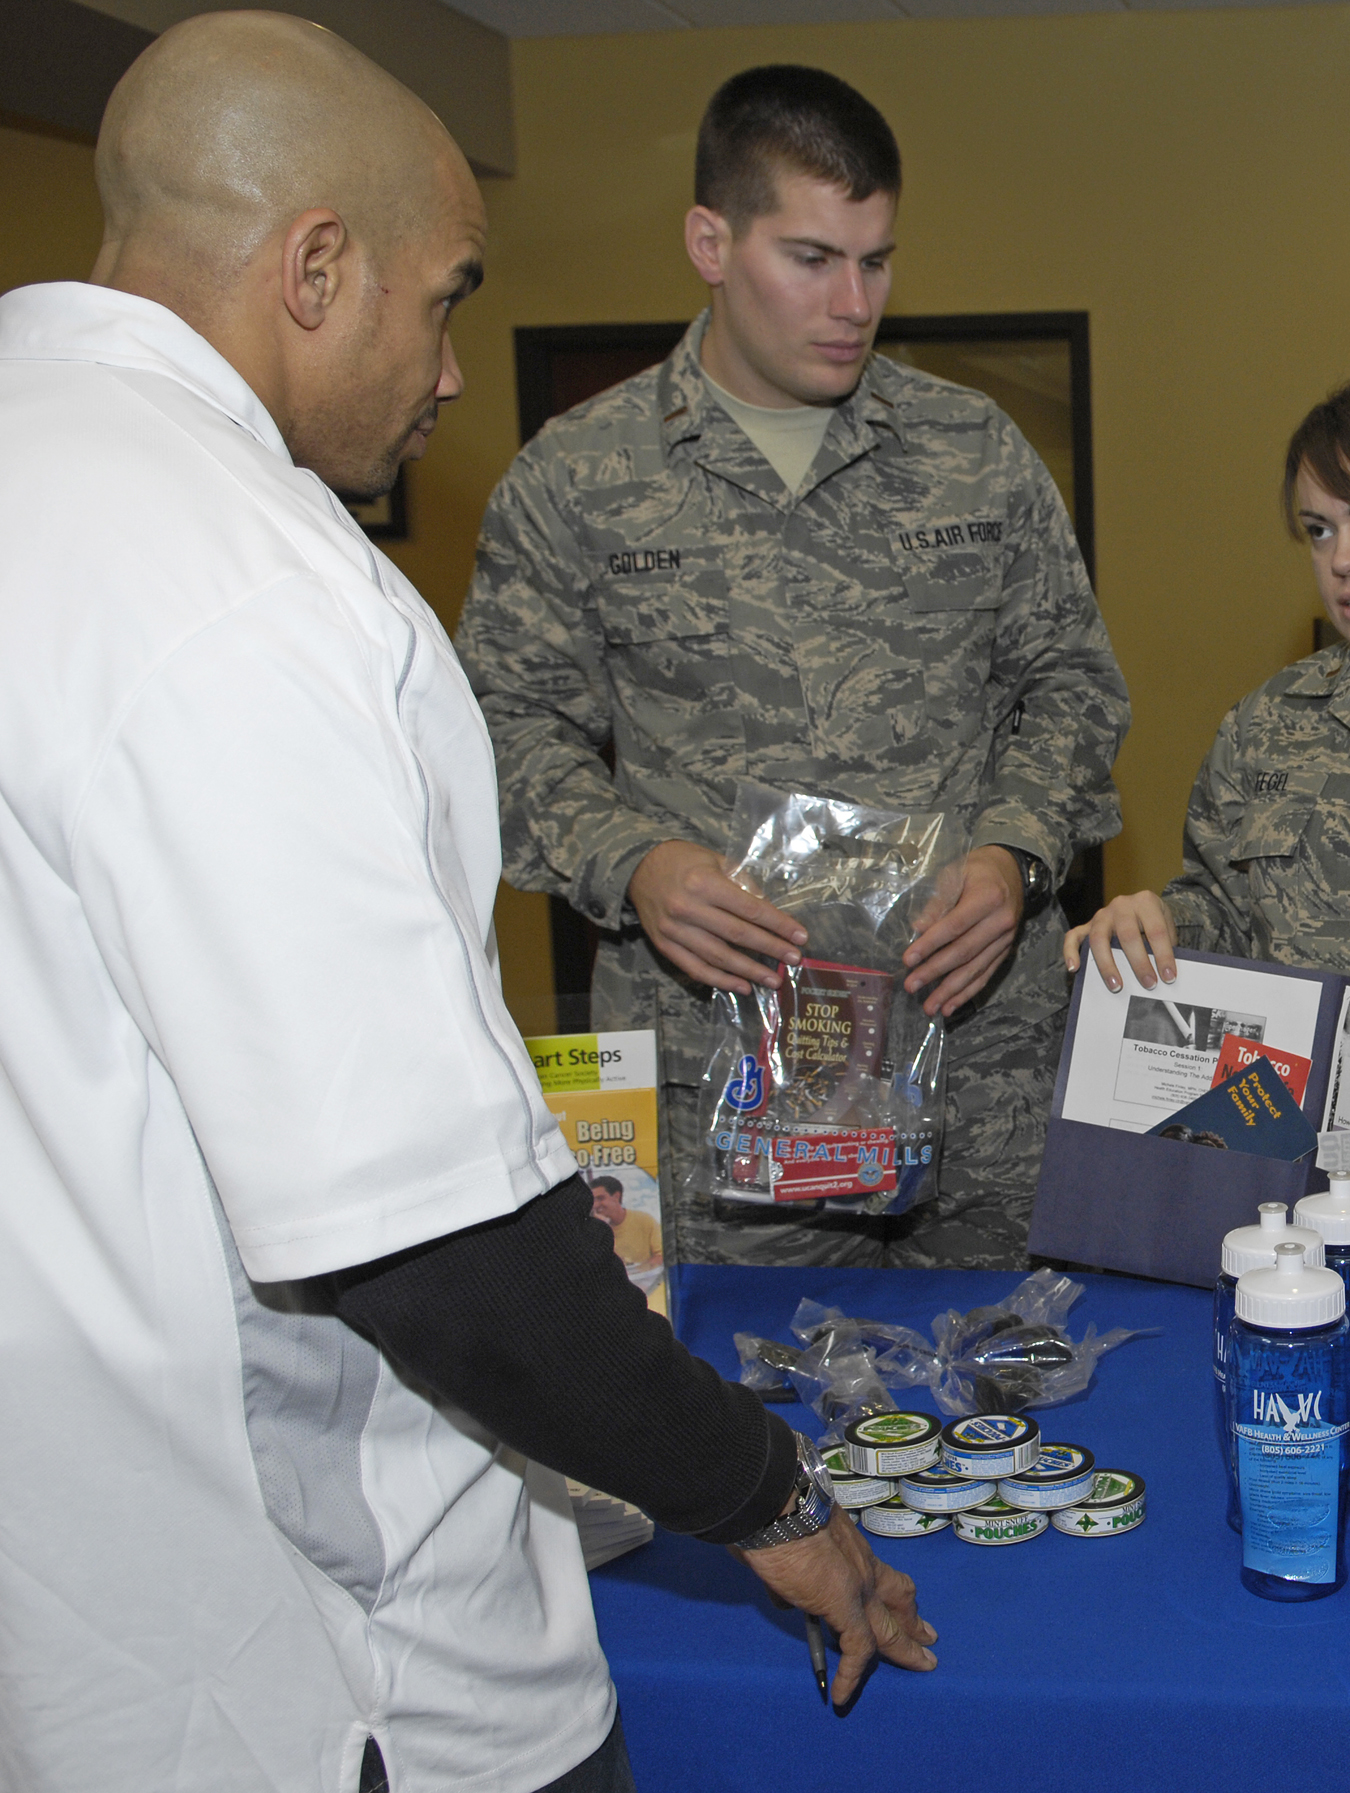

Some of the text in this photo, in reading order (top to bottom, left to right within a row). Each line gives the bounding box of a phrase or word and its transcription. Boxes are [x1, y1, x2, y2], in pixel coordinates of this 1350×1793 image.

[934, 526, 965, 548] AIR
[609, 549, 681, 574] GOLDEN
[805, 1003, 840, 1017] STOP
[788, 1016, 852, 1035] SMOKING
[786, 1031, 849, 1048] Quitting Tips &
[534, 1048, 623, 1069] art Steps
[784, 1048, 848, 1063] Cost Calculator
[1133, 1043, 1168, 1057] Tobacco
[1169, 1050, 1209, 1064] Cessation
[1148, 1065, 1200, 1080] Understanding The
[1174, 1061, 1197, 1071] Session
[1239, 1077, 1260, 1109] Your
[1247, 1072, 1283, 1120] Protect
[1227, 1085, 1257, 1127] Family
[576, 1118, 635, 1143] Being
[593, 1145, 637, 1167] Free
[715, 1131, 849, 1162] GENERAL
[856, 1144, 933, 1167] MILLS
[779, 1180, 854, 1195] www.ucanquit2.org
[1235, 1422, 1253, 1437] VAFB
[1282, 1430, 1292, 1442] &
[1261, 1443, 1325, 1456] (805) 606-2221
[974, 1518, 1039, 1540] POUCHES
[984, 1515, 1030, 1528] MINT SNUFF
